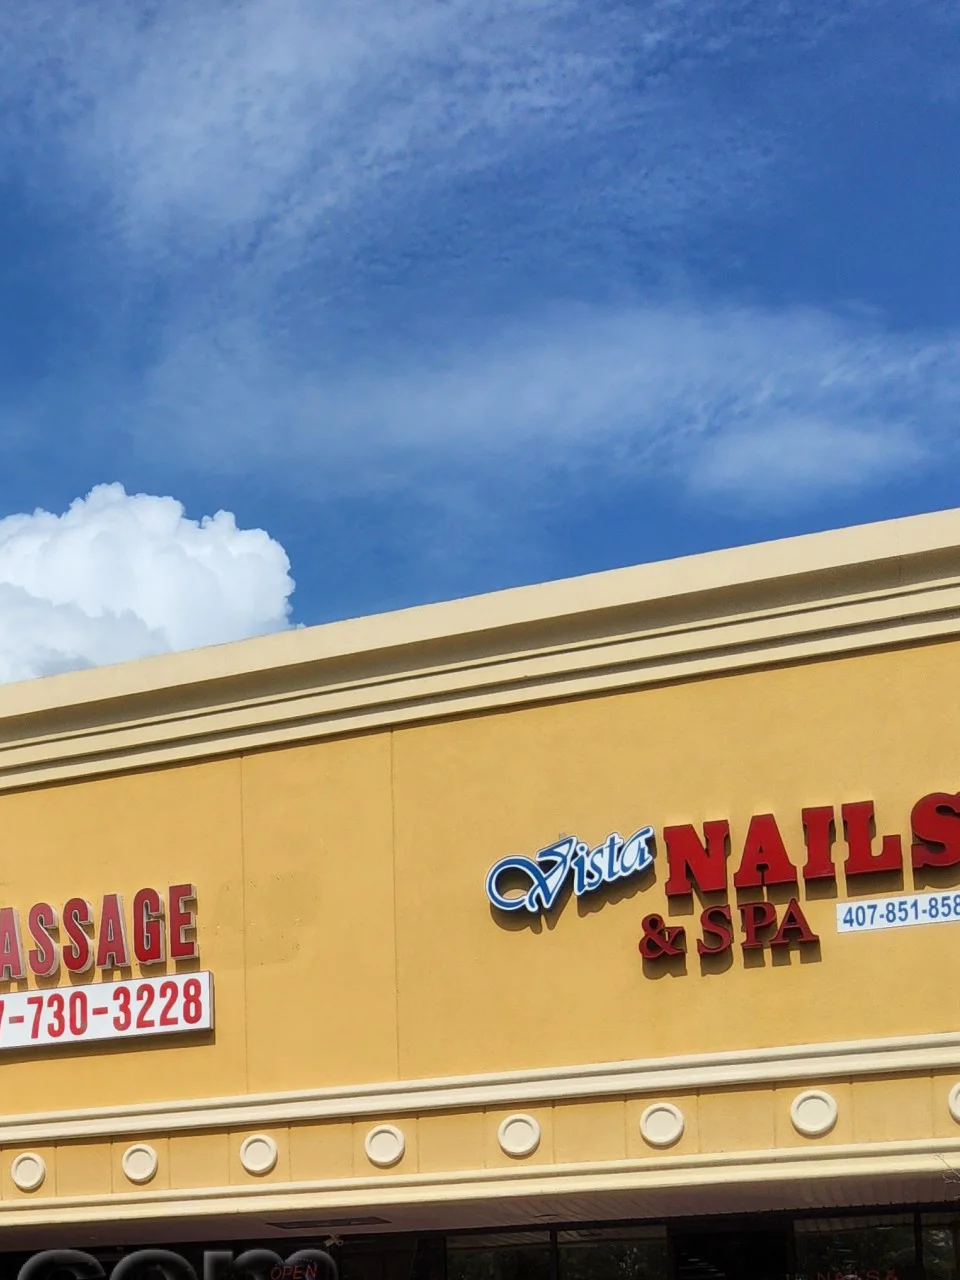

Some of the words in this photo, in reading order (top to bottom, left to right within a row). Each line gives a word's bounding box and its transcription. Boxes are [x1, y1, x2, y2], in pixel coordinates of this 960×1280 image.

[485, 826, 655, 912] Vista
[663, 792, 960, 895] NAILS
[639, 913, 684, 959] &
[697, 897, 818, 955] SPA
